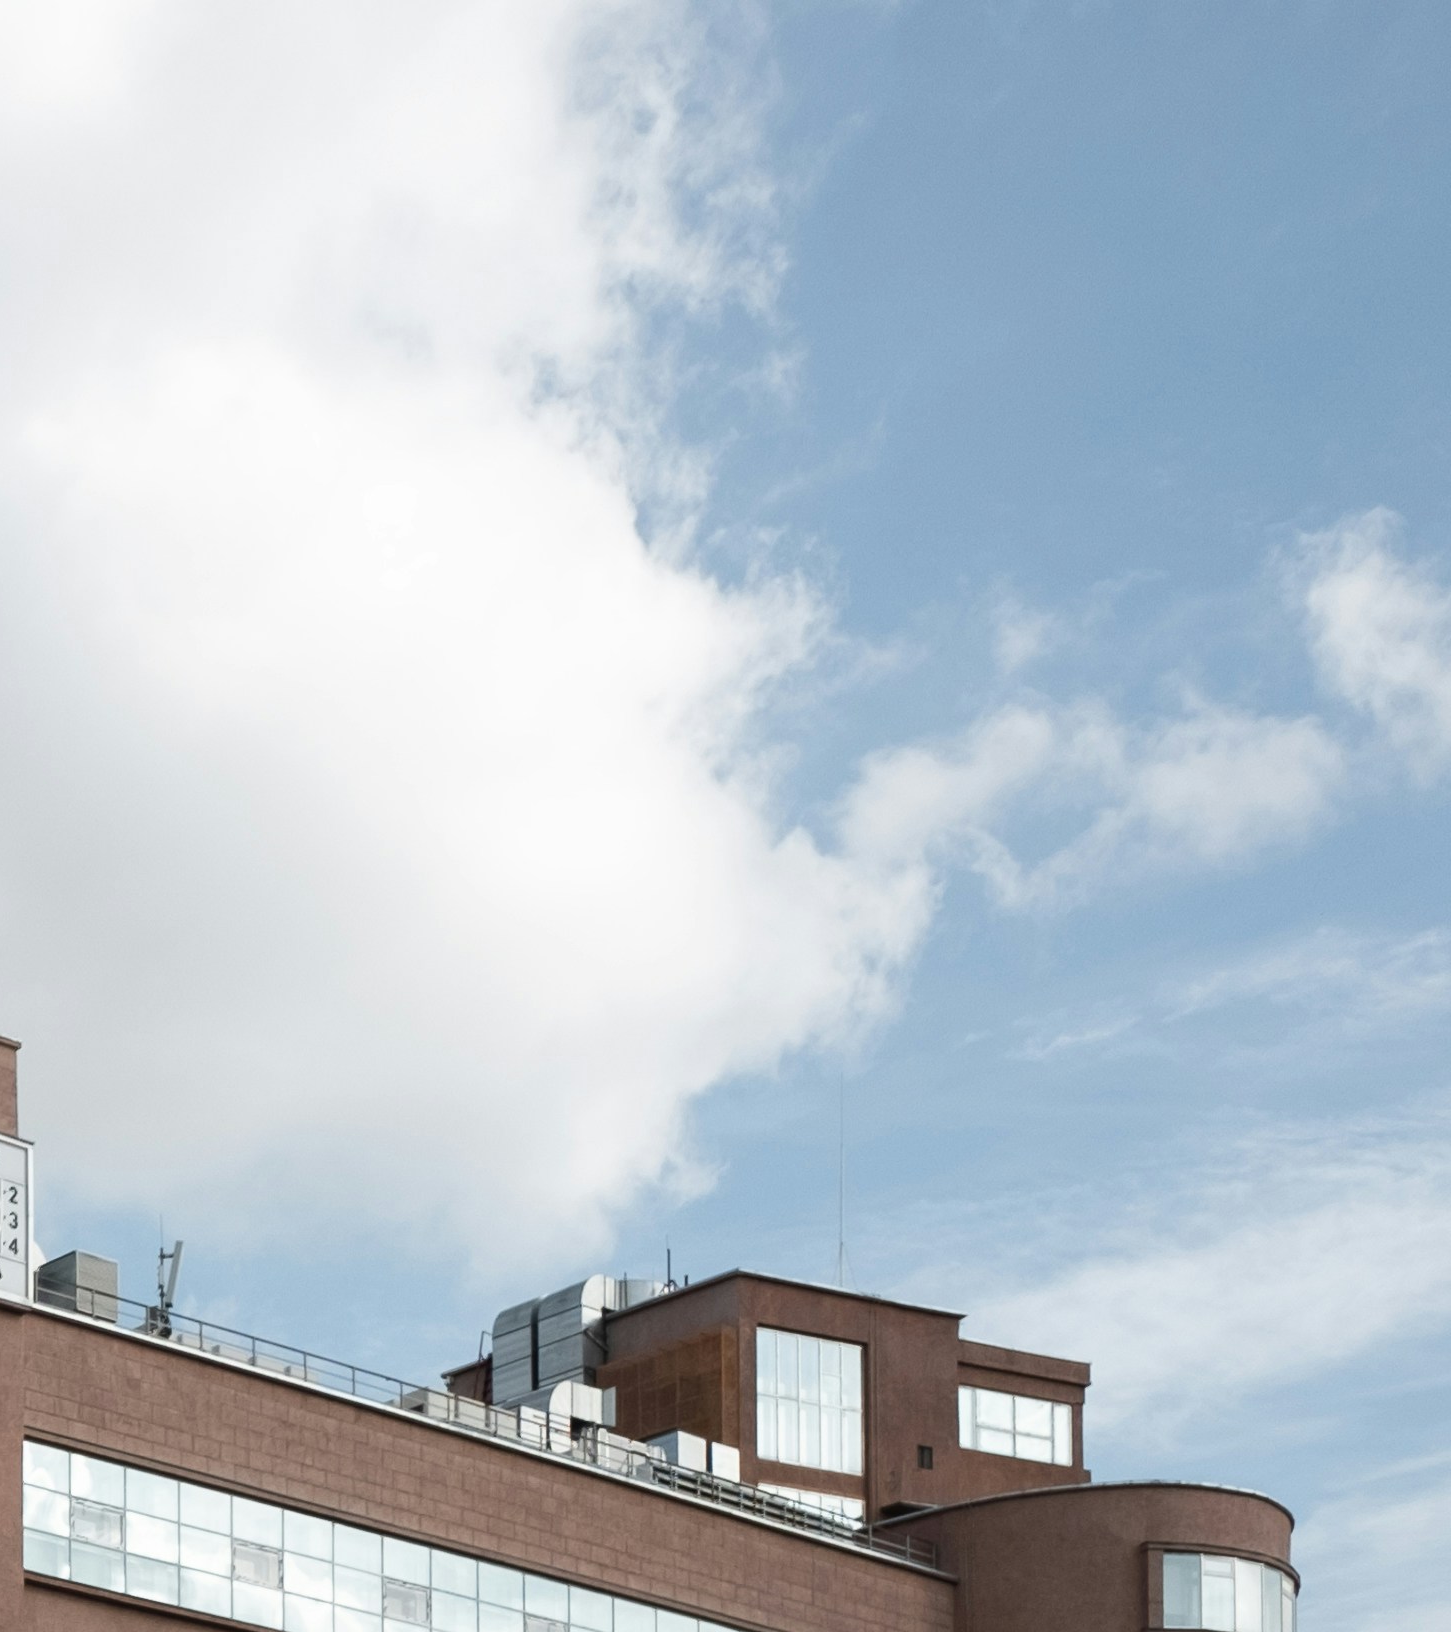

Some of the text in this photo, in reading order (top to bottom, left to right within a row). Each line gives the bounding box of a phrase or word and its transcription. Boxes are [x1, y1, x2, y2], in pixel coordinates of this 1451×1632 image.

[9, 1186, 18, 1204] 2
[9, 1212, 18, 1229] 3
[9, 1238, 19, 1255] 4
